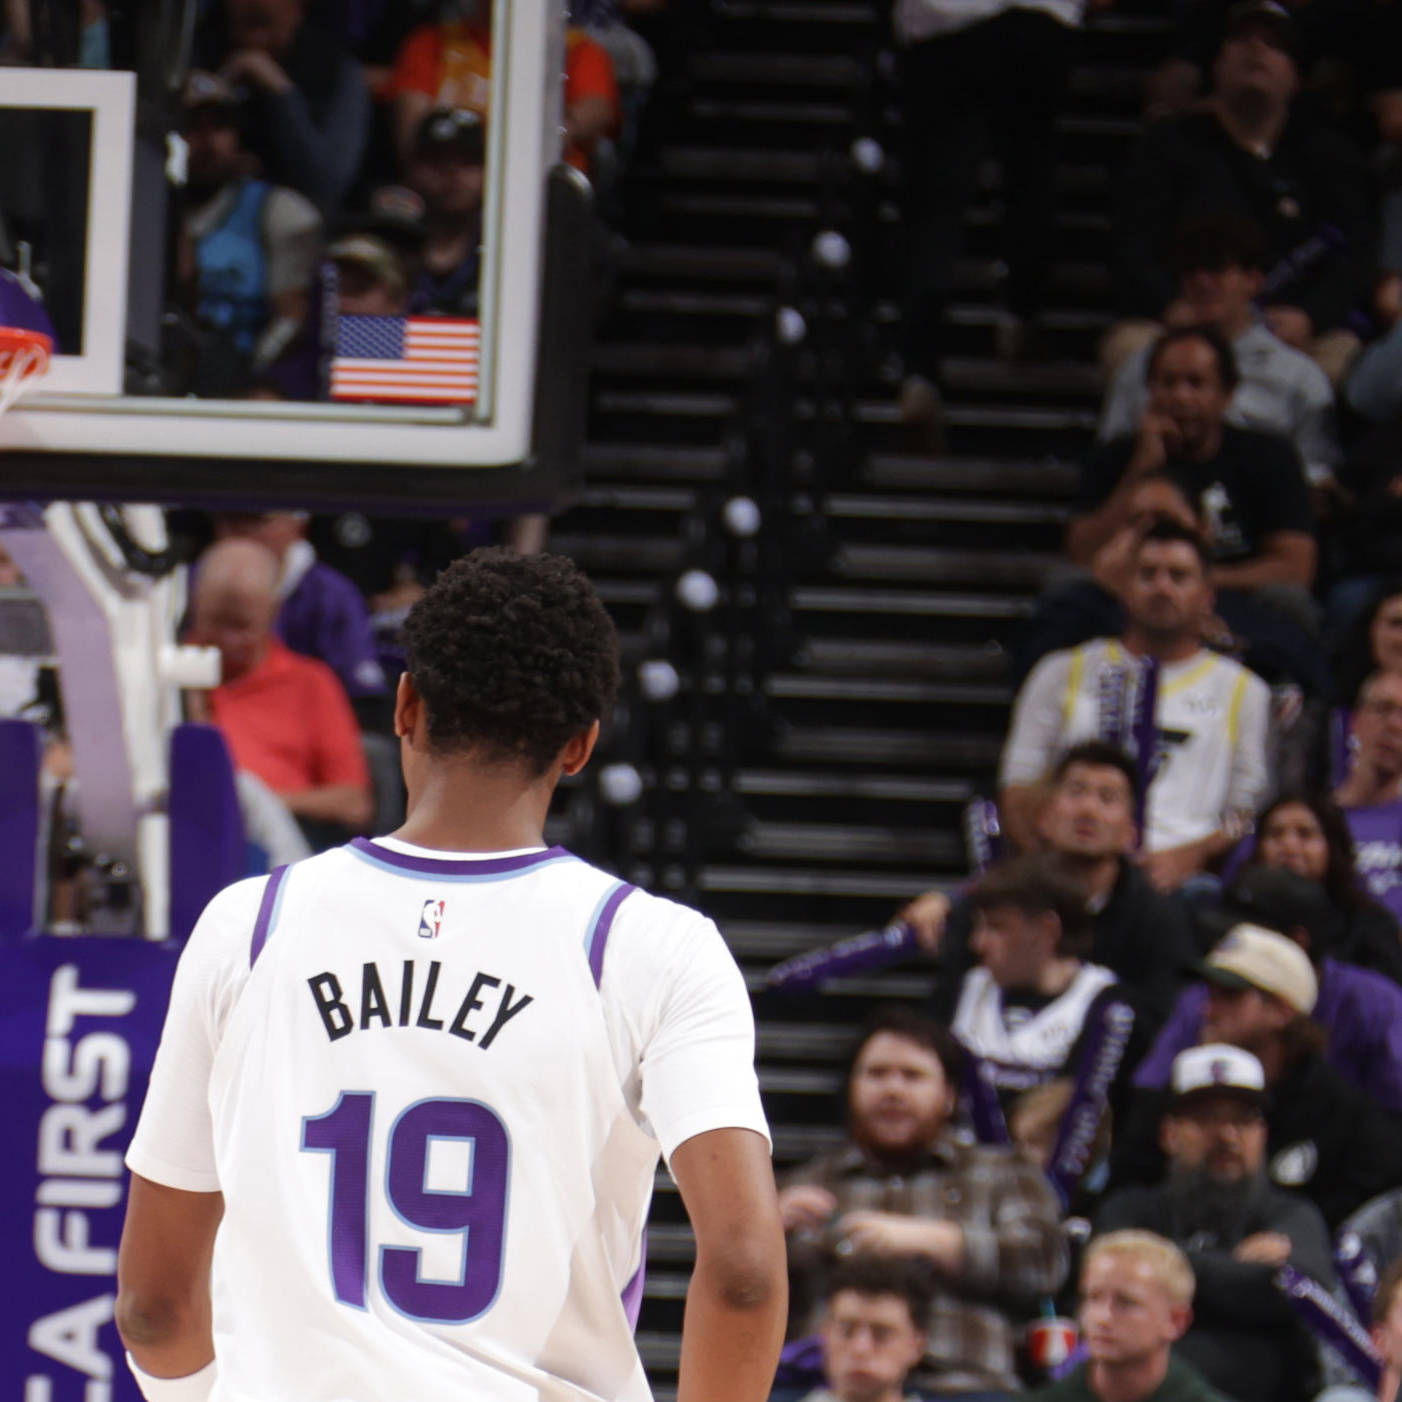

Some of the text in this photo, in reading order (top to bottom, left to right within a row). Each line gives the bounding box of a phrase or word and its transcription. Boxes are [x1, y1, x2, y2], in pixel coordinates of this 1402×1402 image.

[34, 963, 138, 1275] FIRST
[307, 960, 534, 1051] BAILEY
[299, 1090, 513, 1326] 19
